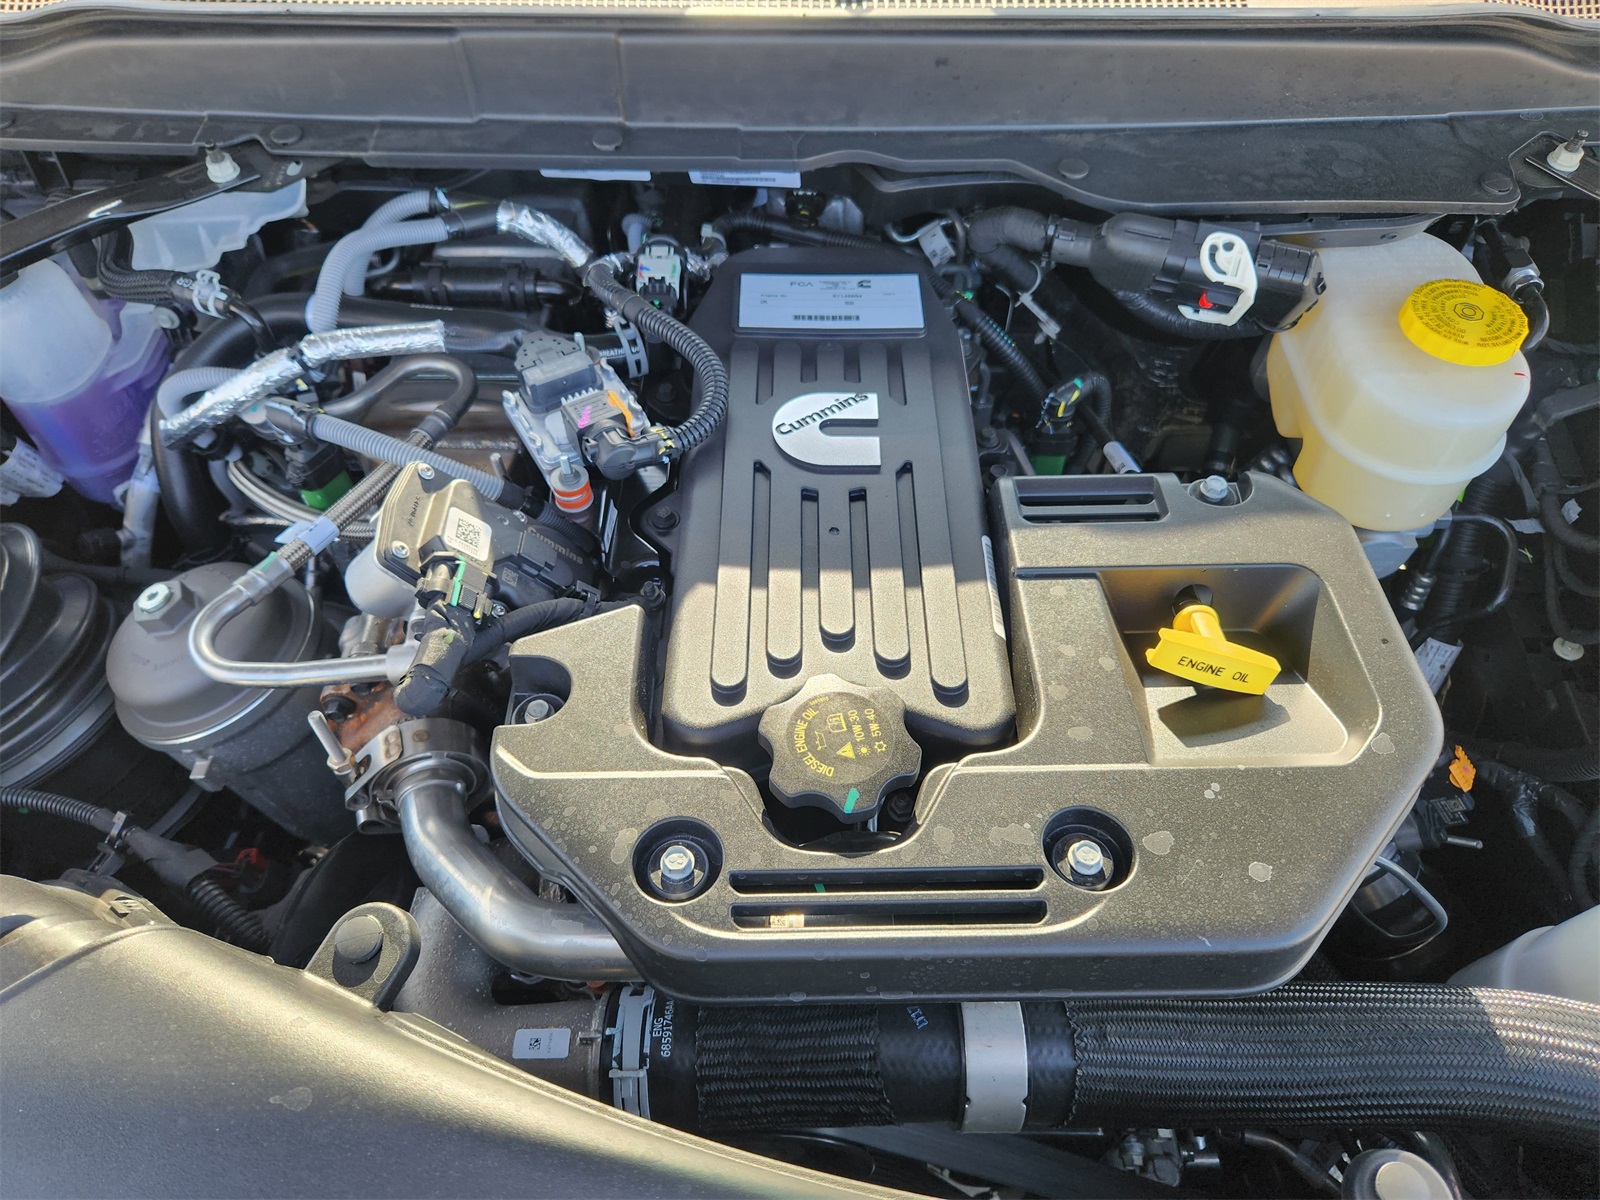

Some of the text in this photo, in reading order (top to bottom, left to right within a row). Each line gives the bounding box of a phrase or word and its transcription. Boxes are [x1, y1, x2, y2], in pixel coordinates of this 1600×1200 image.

[599, 348, 625, 357] BREATH
[775, 392, 869, 435] Cummins
[528, 527, 584, 565] Cummins
[1177, 656, 1249, 683] ENGINE OIL
[848, 709, 865, 742] 10W-30
[864, 708, 882, 737] 5W-40
[794, 707, 835, 777] DIESEL ENGINE OIL
[653, 1017, 664, 1037] ENG
